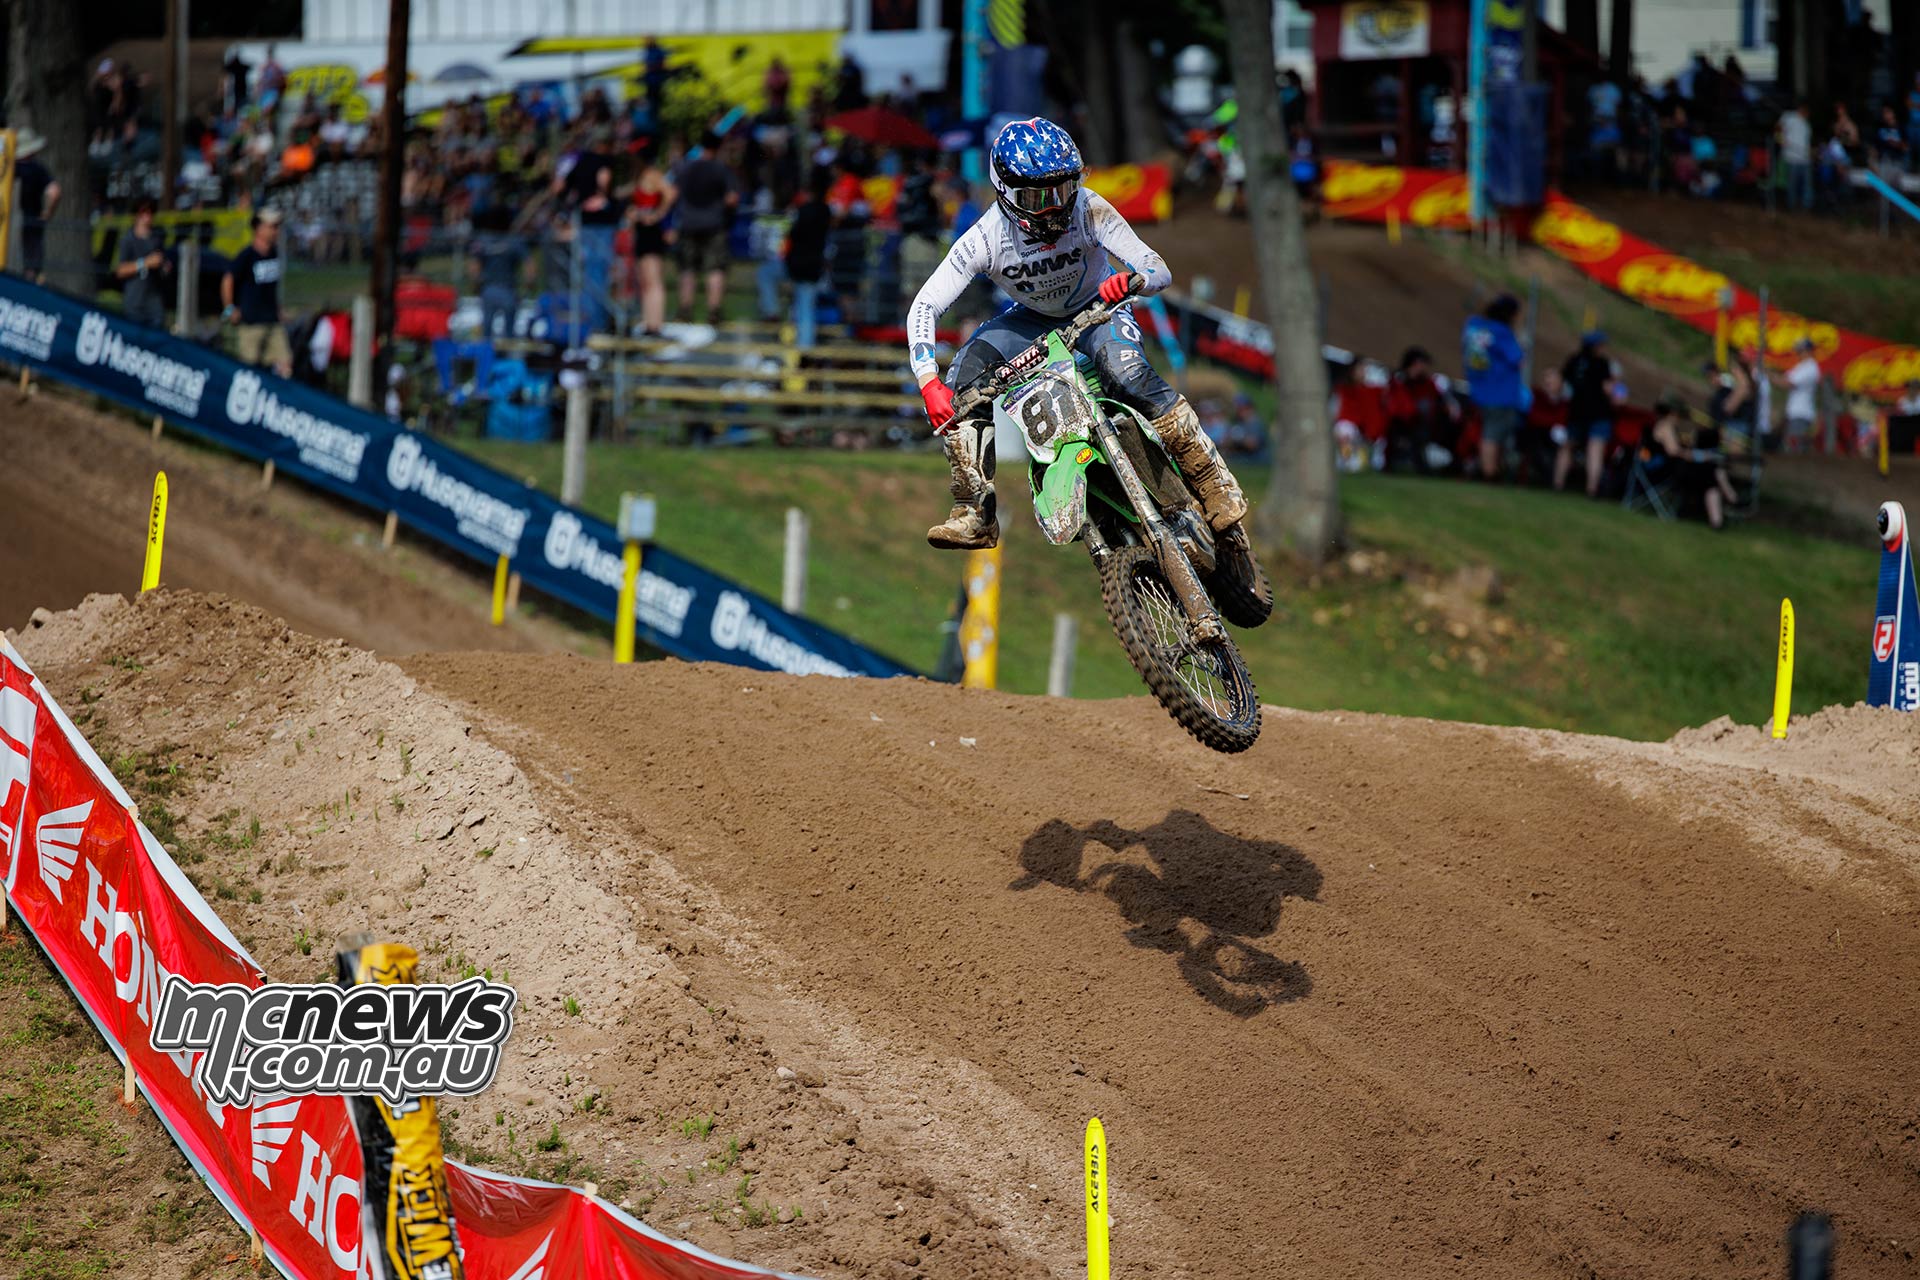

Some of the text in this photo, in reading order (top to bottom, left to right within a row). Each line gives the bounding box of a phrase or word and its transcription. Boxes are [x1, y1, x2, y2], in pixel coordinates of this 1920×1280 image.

[1001, 247, 1082, 280] CANVAS
[99, 327, 206, 400] Husqvarna
[252, 387, 367, 464] Husqvarna
[1021, 379, 1080, 447] 81
[410, 454, 526, 540] Husqvarna
[570, 532, 692, 619] Husarna
[739, 612, 867, 678] Husqvar
[1090, 1144, 1099, 1214] ACERBIS
